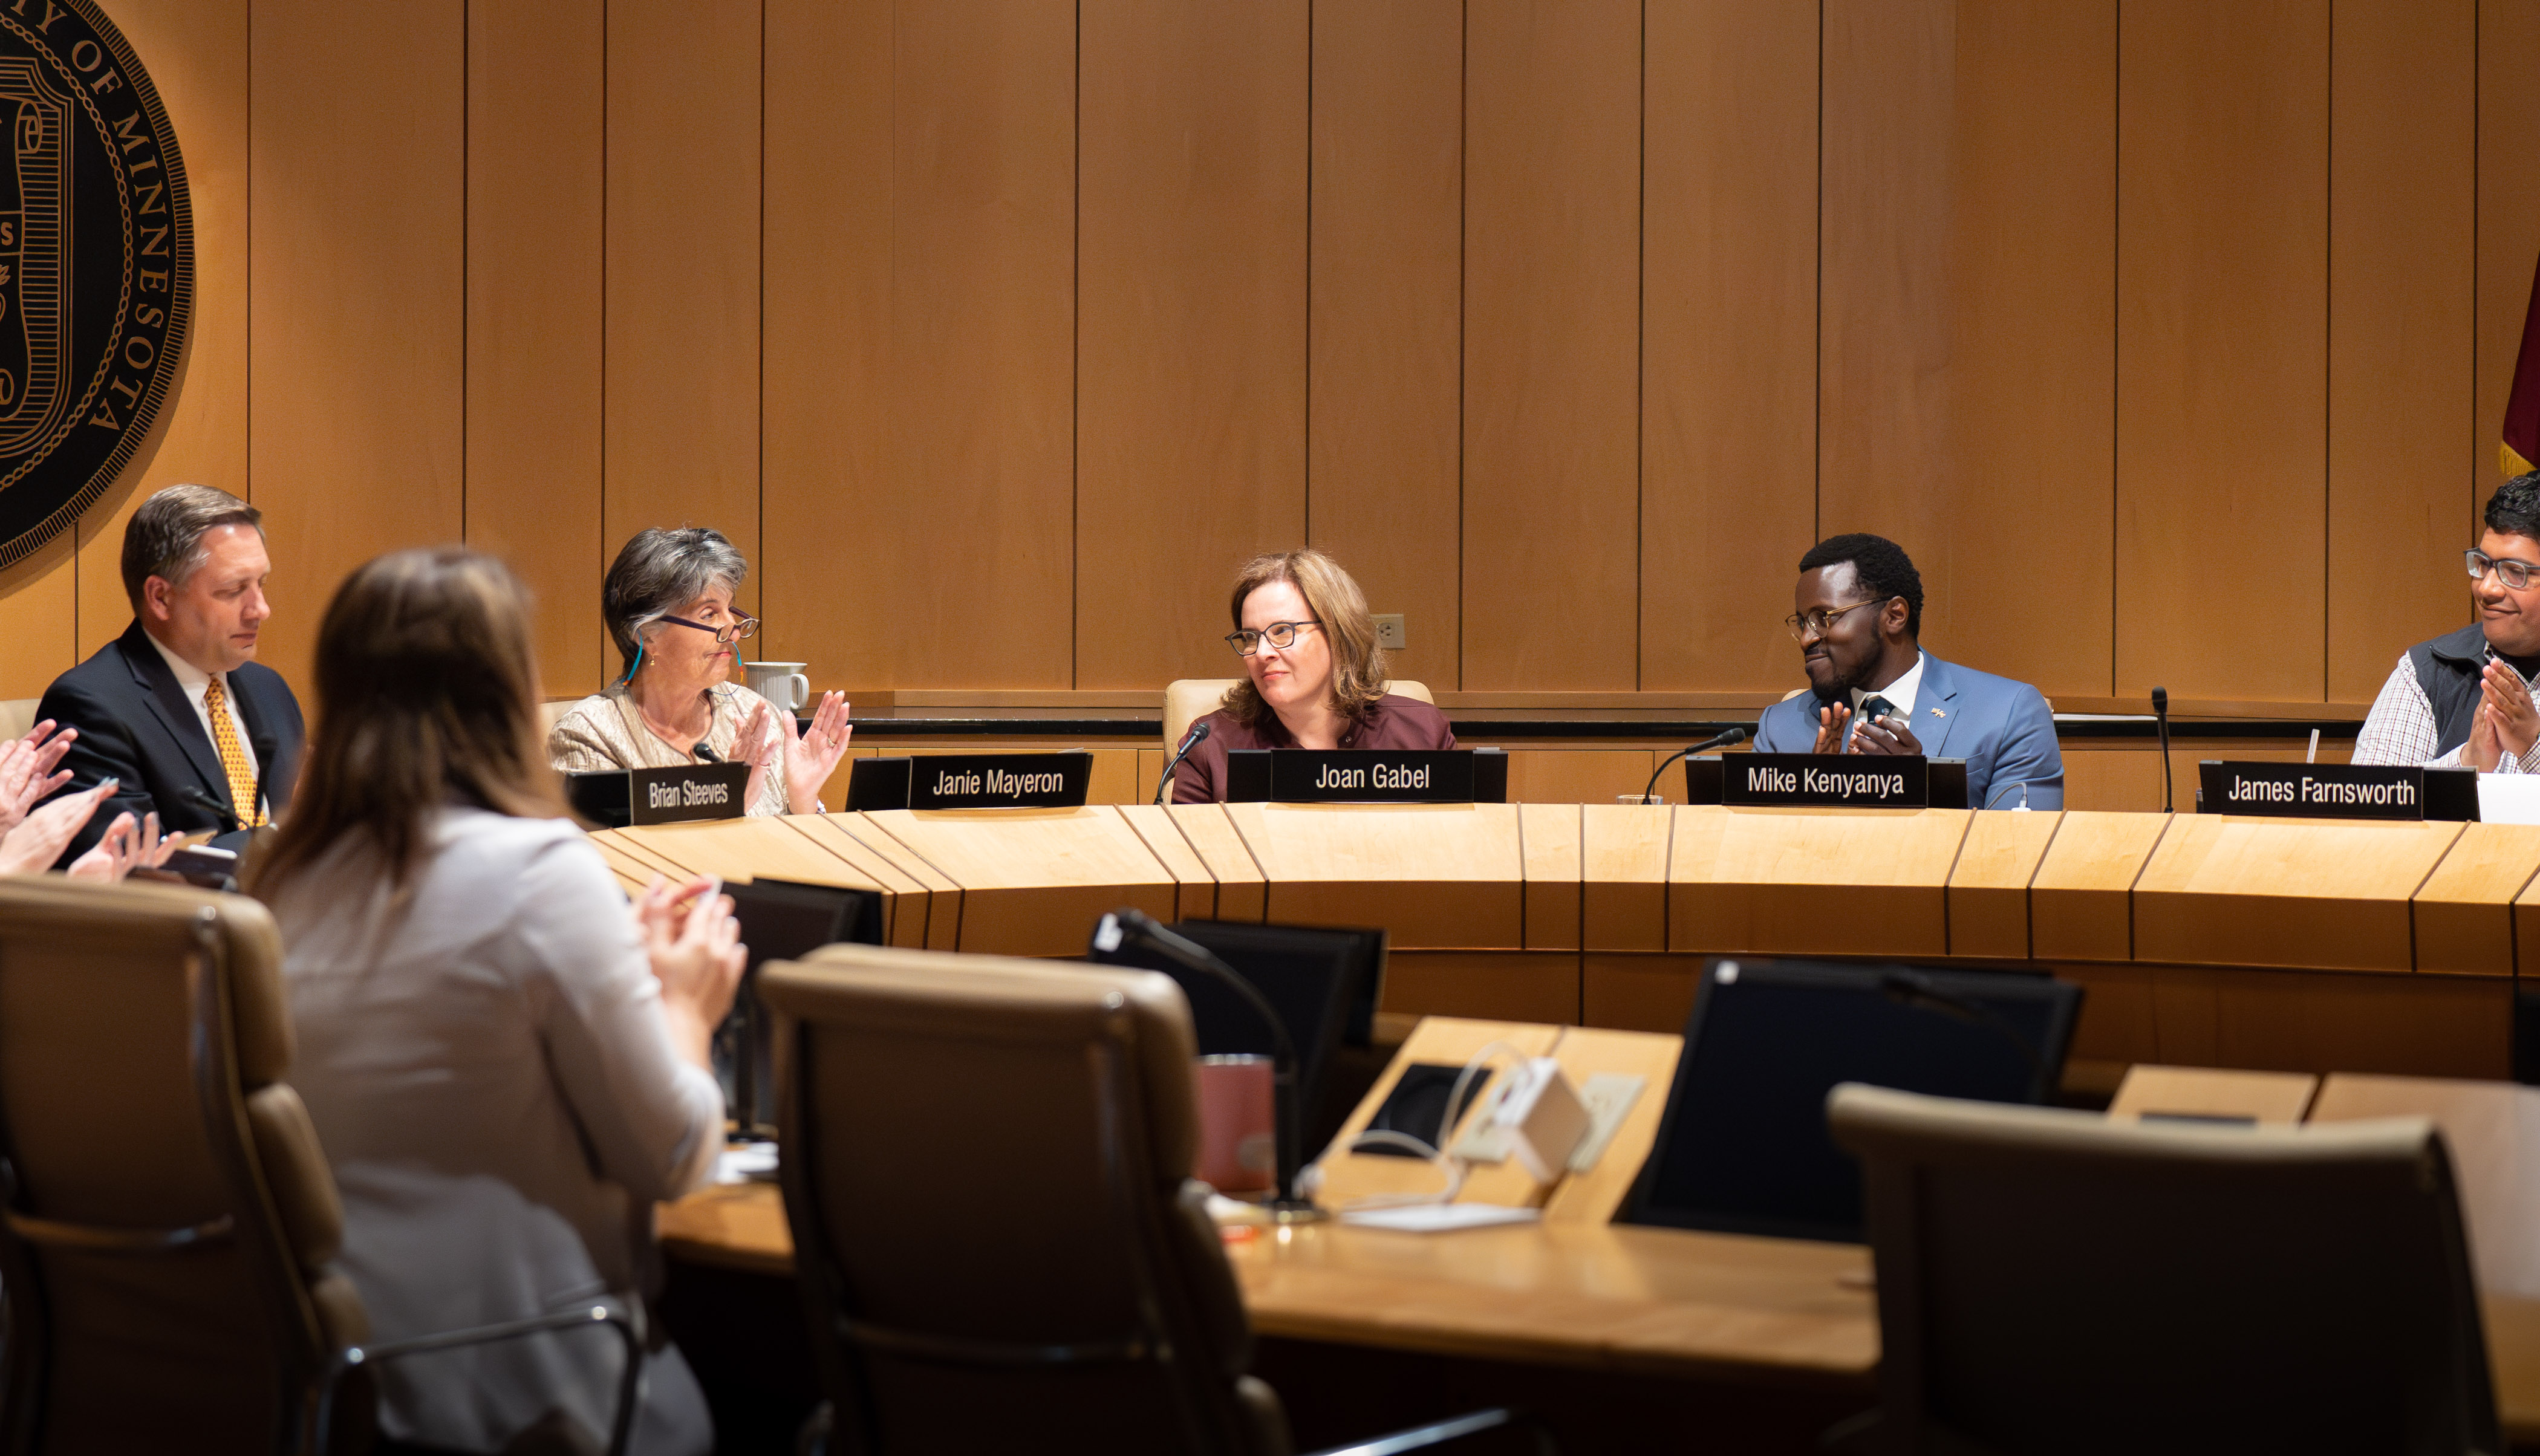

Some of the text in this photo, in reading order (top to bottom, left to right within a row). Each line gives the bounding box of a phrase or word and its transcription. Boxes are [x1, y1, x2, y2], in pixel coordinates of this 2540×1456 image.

[71, 39, 123, 95] OF
[88, 109, 169, 431] MINNESOTA
[933, 769, 1064, 799] Janie Mayeron
[1315, 763, 1430, 789] Joan Gabel
[1748, 767, 1905, 799] Mike Kenyanya
[2228, 774, 2415, 806] James Farnsworth
[648, 779, 729, 809] Brian Steeves
